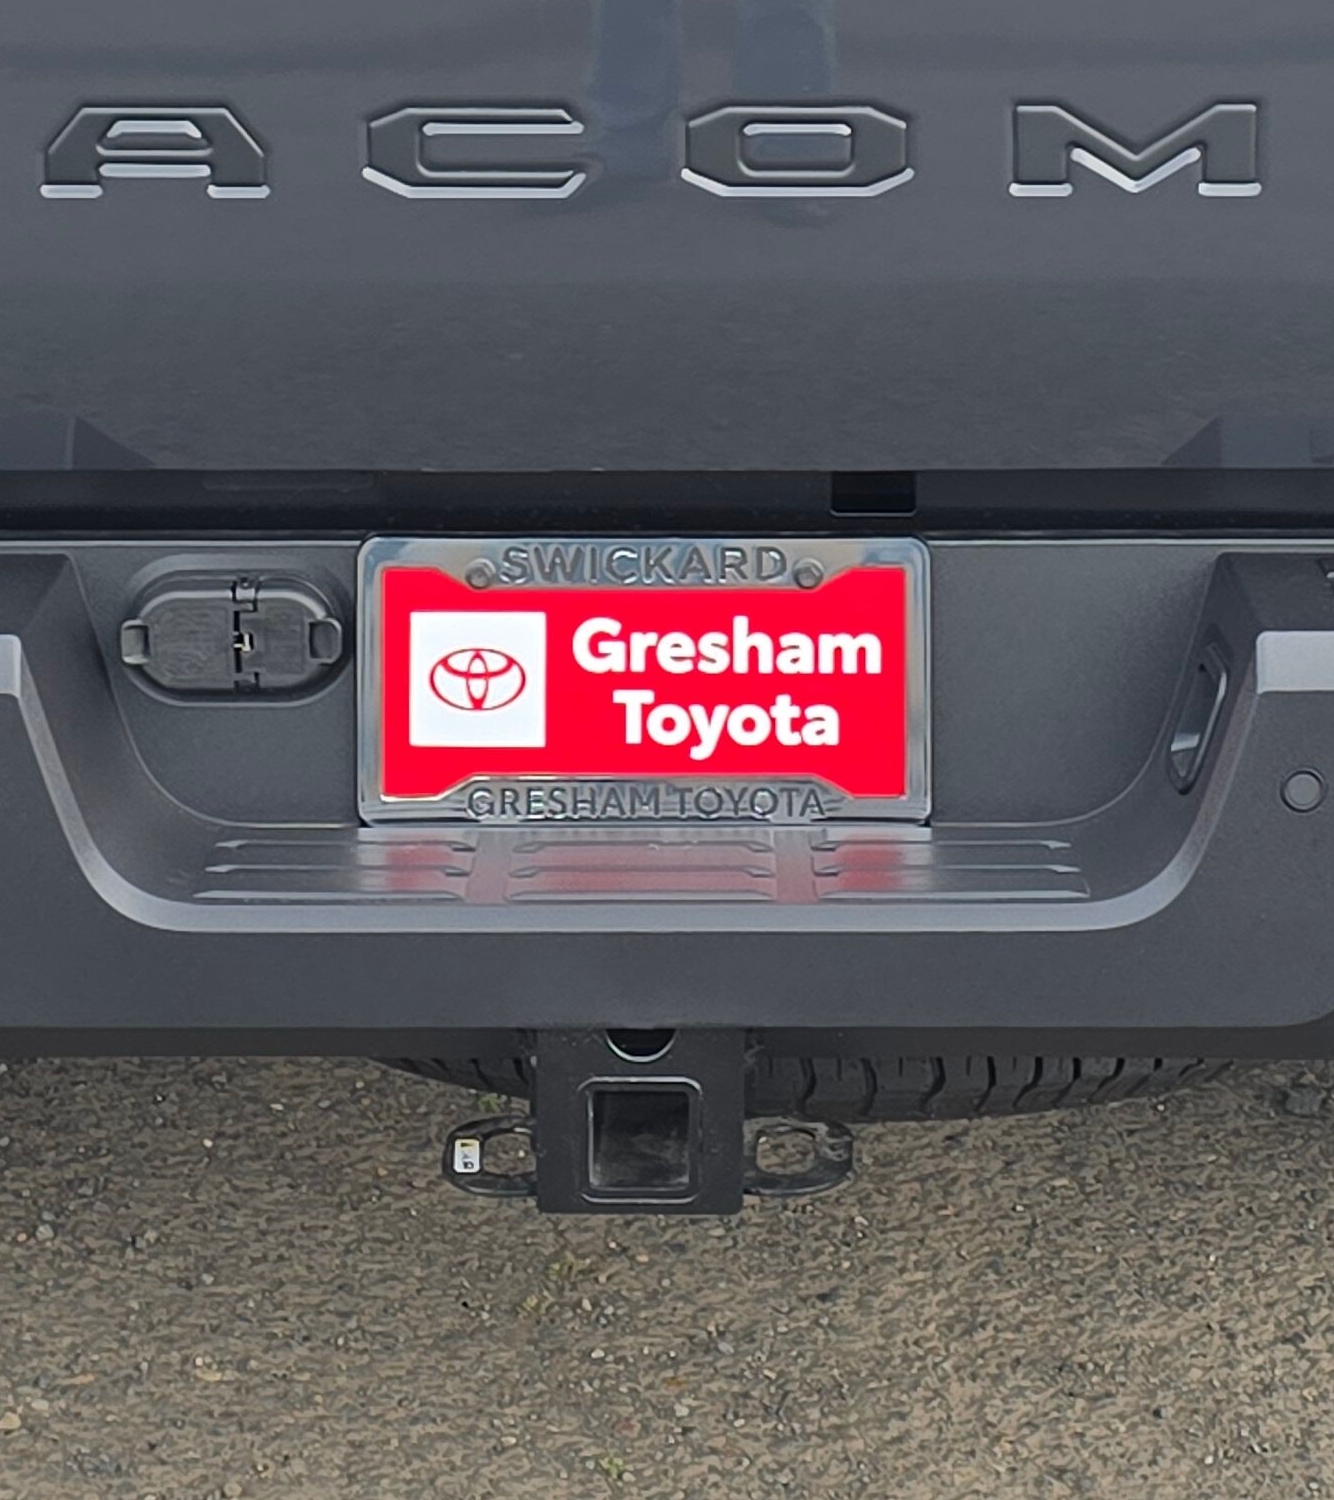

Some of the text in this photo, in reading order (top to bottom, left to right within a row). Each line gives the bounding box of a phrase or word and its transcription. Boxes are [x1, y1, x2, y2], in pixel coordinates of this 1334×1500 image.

[499, 544, 789, 586] SWICKARD
[572, 615, 882, 675] Gresham
[613, 689, 841, 761] Toyota
[467, 786, 828, 821] GRESHAM TOYOTA
